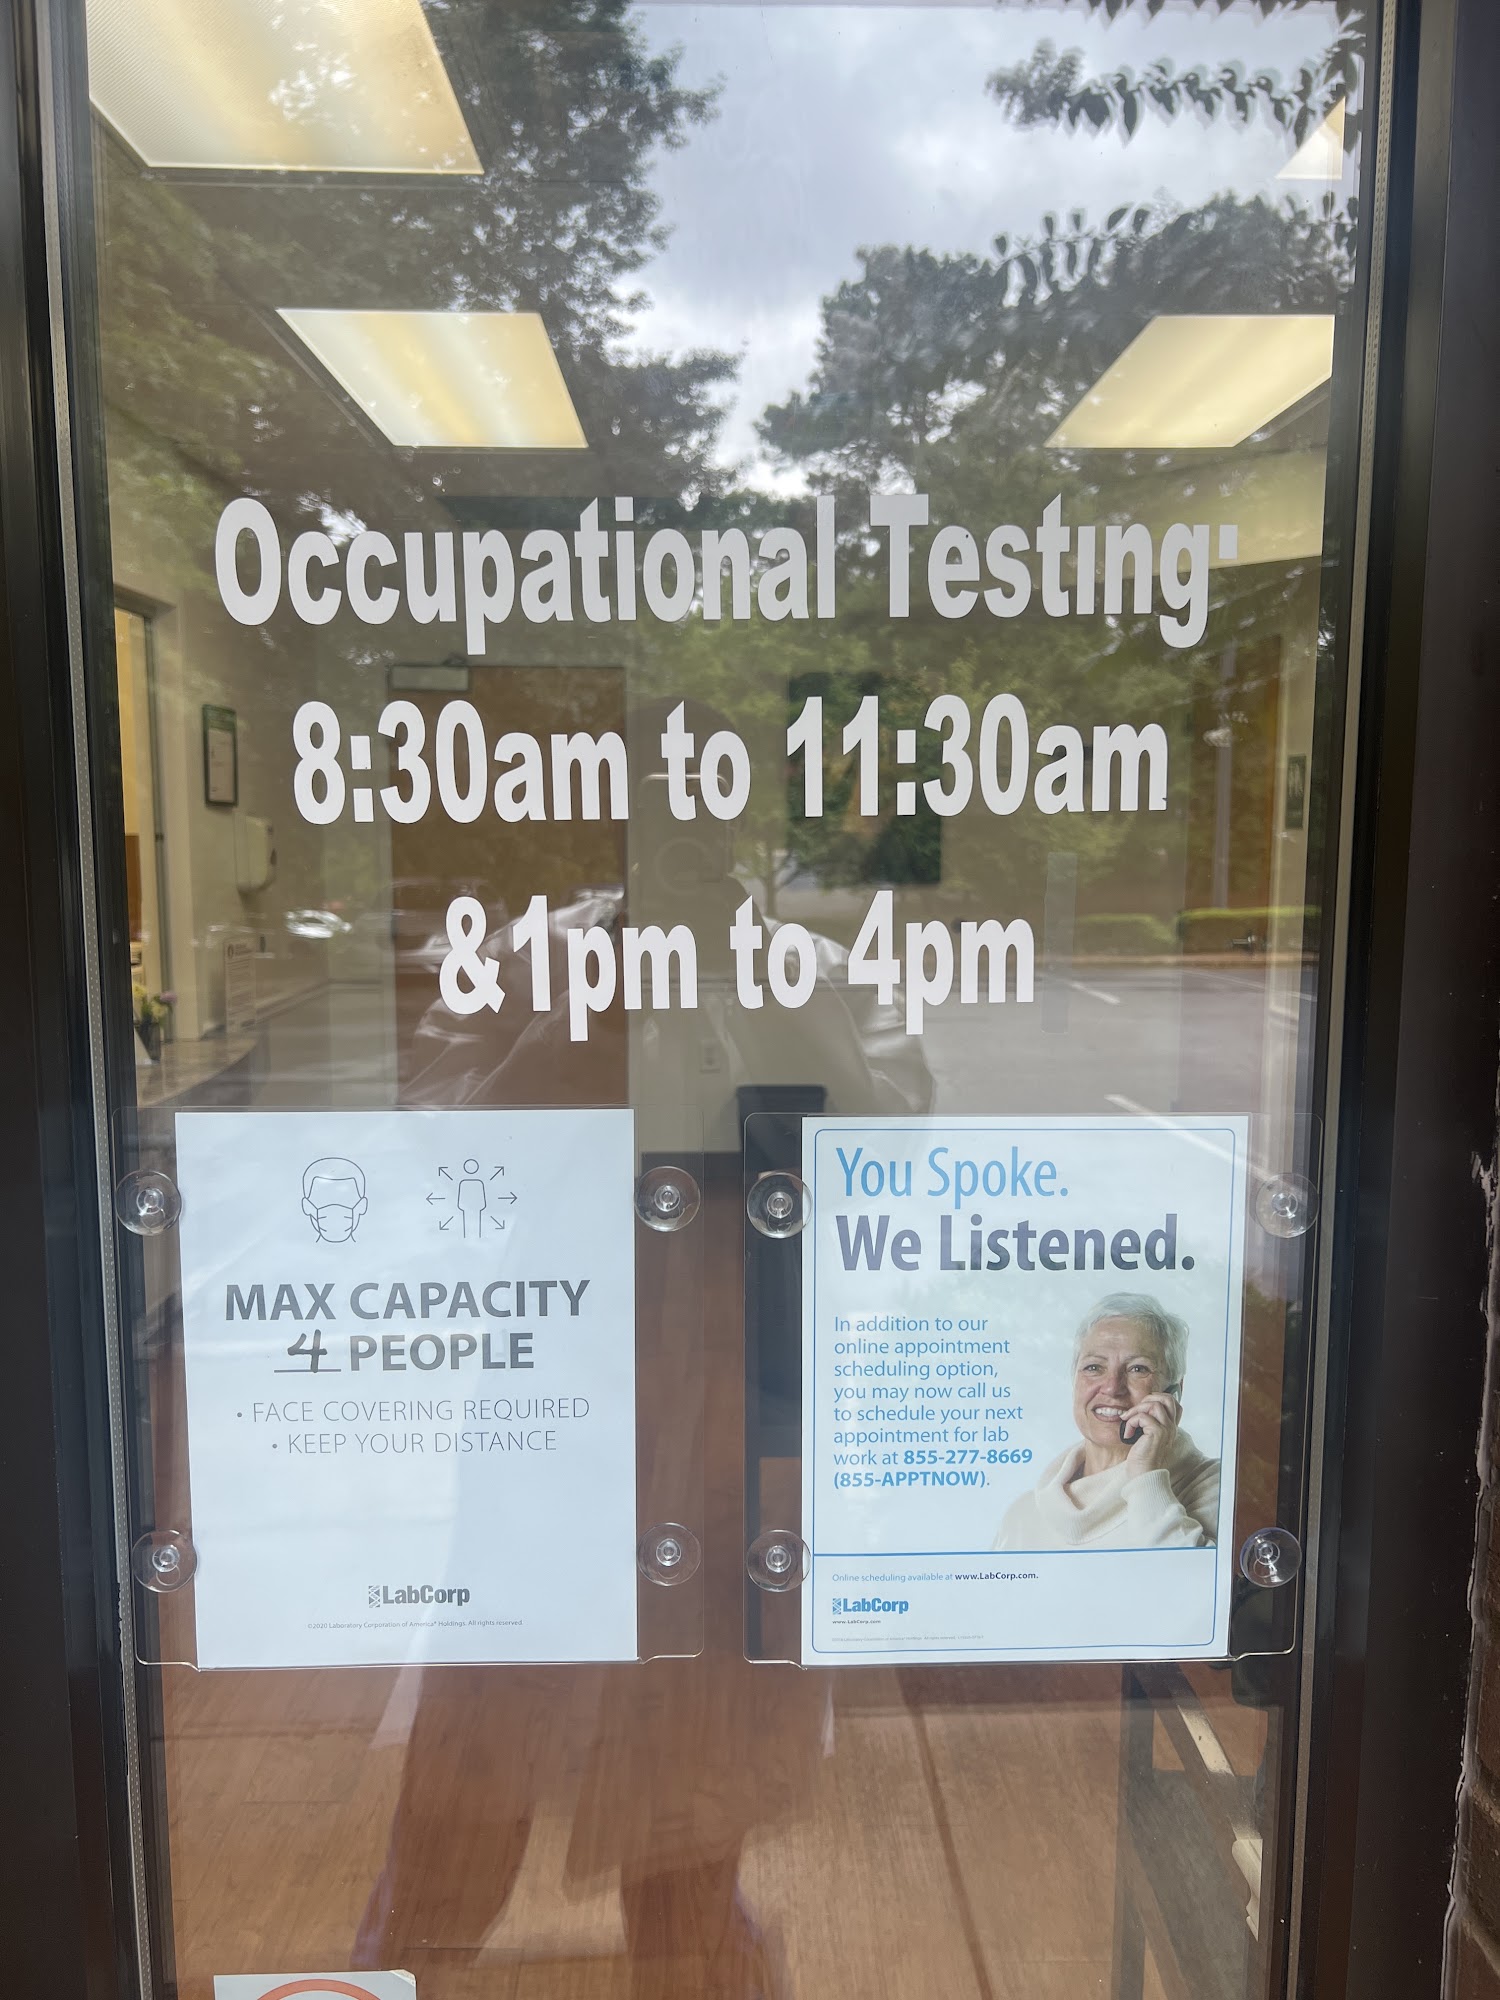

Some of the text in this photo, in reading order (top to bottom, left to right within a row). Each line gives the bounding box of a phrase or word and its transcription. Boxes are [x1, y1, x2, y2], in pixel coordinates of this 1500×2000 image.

[215, 494, 836, 656] Occupational
[293, 694, 1168, 826] 8:30am to 11:30am
[729, 895, 818, 1010] to
[848, 888, 1035, 1035] 4pm
[835, 1146, 1069, 1210] You Spoke.
[835, 1212, 1195, 1271] We Listened.
[225, 1279, 591, 1321] MAX CAPACITY
[834, 1315, 988, 1331] In addition to our
[286, 1328, 535, 1374] 4 PEOPLE
[834, 1338, 1011, 1357] online appointment
[834, 1360, 998, 1380] scheduling option,
[833, 1382, 1011, 1403] you may now call us
[252, 1397, 590, 1423] FACE COVERING REQUIRED
[833, 1405, 1024, 1424] to schedule your next
[288, 1430, 558, 1454] KEEP YOUR DISTANCE
[833, 1426, 1009, 1447] appointment for lab
[833, 1448, 1033, 1466] work at 855-277-8669
[833, 1471, 990, 1489] (855-APPTNOW).
[832, 1571, 1039, 1583] Online scheduling available at www.LabCorp.com.
[382, 1584, 470, 1607] LabCorp
[842, 1598, 909, 1614] LabCorp
[328, 1622, 363, 1630] Laboratory
[363, 1621, 401, 1629] Corporation
[476, 1619, 495, 1627] rights
